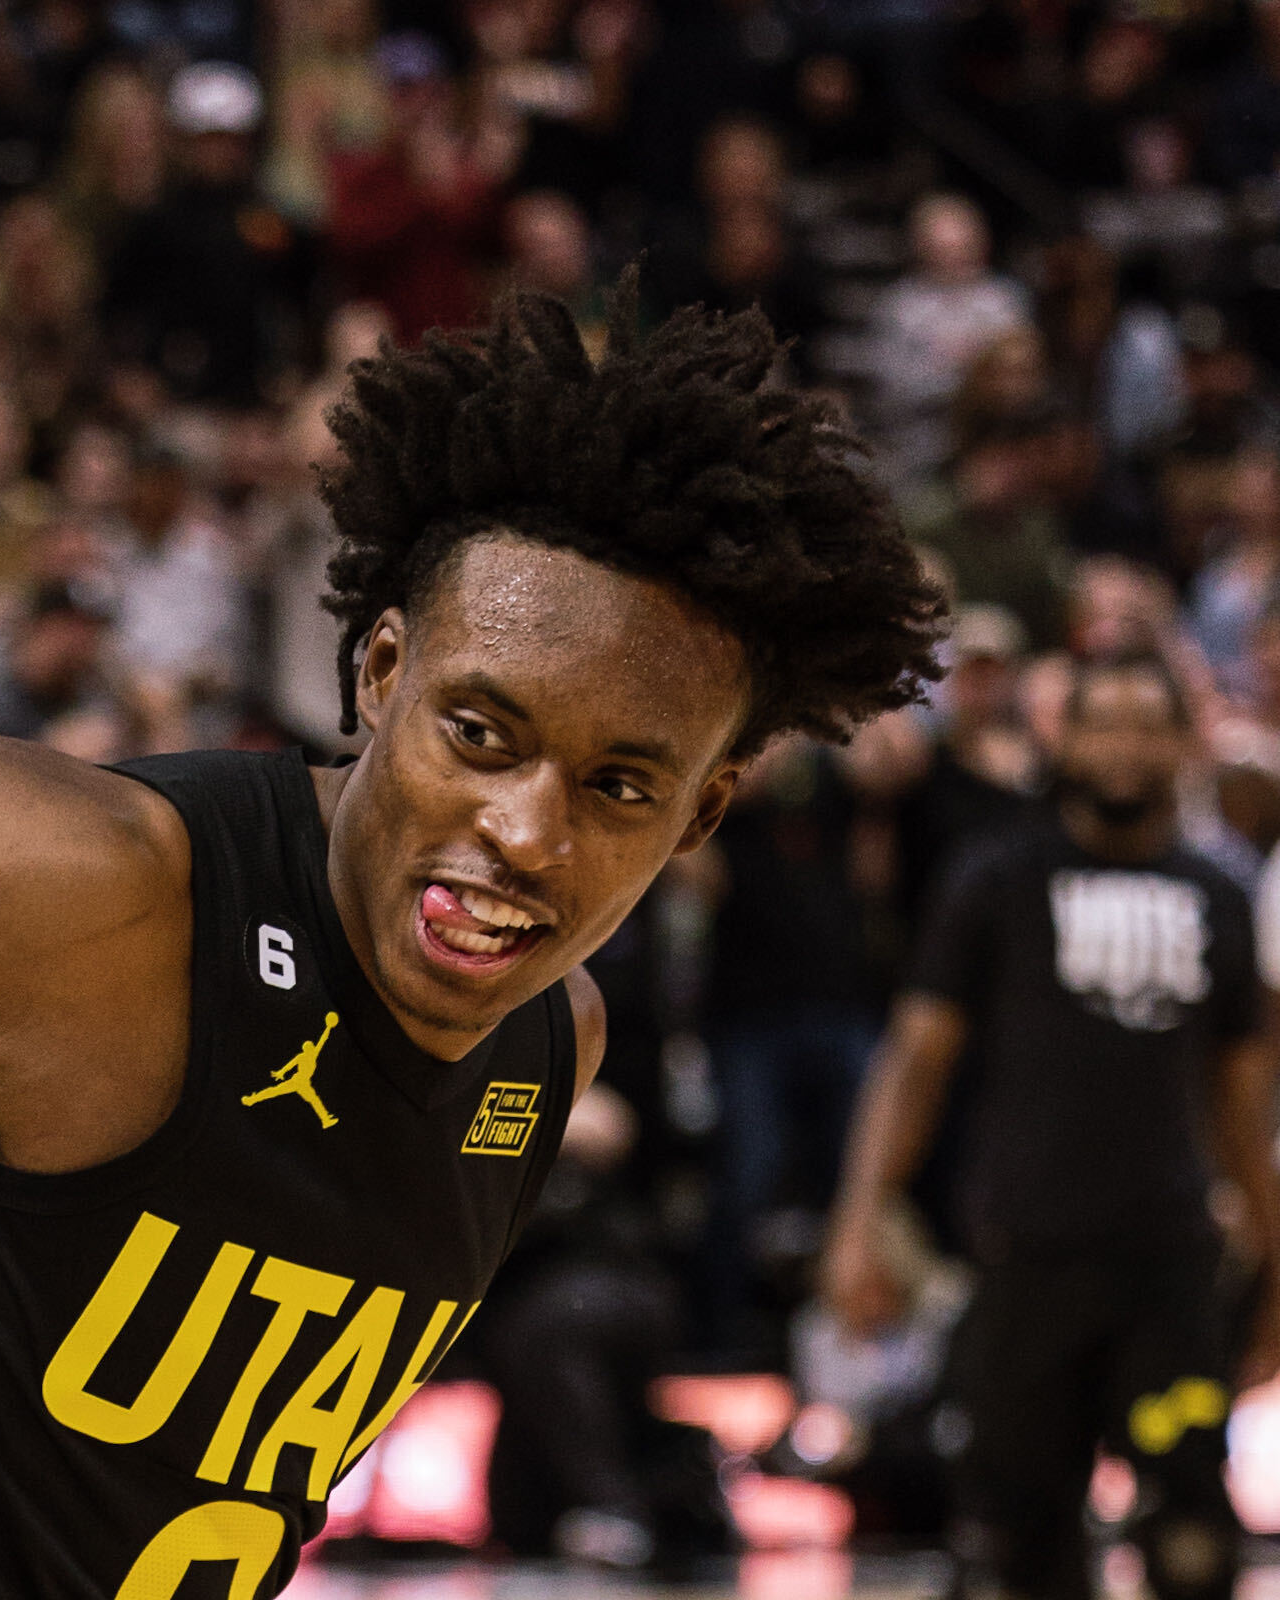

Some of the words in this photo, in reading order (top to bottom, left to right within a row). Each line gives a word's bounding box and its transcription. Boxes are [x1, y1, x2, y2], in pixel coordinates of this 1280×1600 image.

[258, 923, 297, 991] 6
[470, 1092, 499, 1144] 5
[500, 1093, 515, 1108] FOR
[515, 1094, 530, 1108] THE
[486, 1120, 527, 1146] FIGHT
[41, 1210, 482, 1502] UTAH
